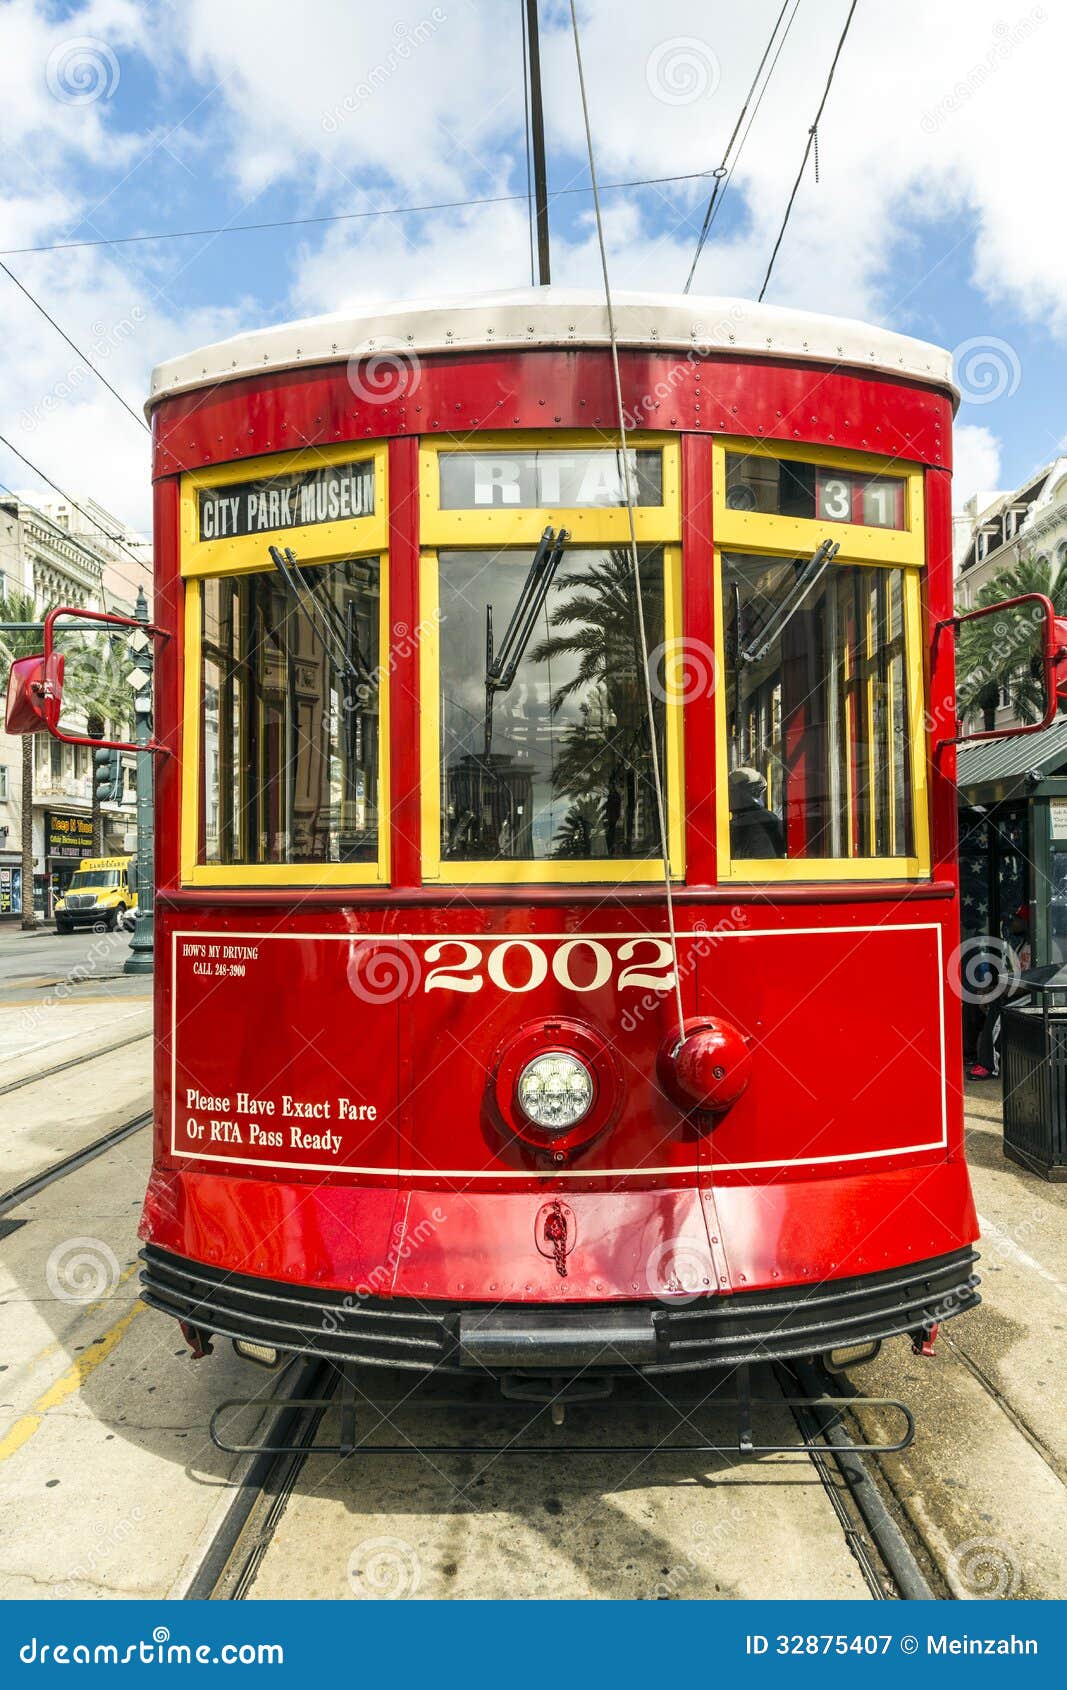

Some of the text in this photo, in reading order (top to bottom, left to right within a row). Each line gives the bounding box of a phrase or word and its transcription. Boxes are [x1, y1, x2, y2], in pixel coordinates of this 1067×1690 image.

[474, 459, 629, 504] RTA
[203, 497, 240, 538] CITY
[183, 944, 259, 960] HOW'S MY DRIVING
[193, 961, 246, 977] CALL 248-3900
[424, 939, 678, 993] 2002
[186, 1088, 377, 1121] Please Have Exact Fare
[186, 1118, 343, 1155] Or RTA Pass Ready
